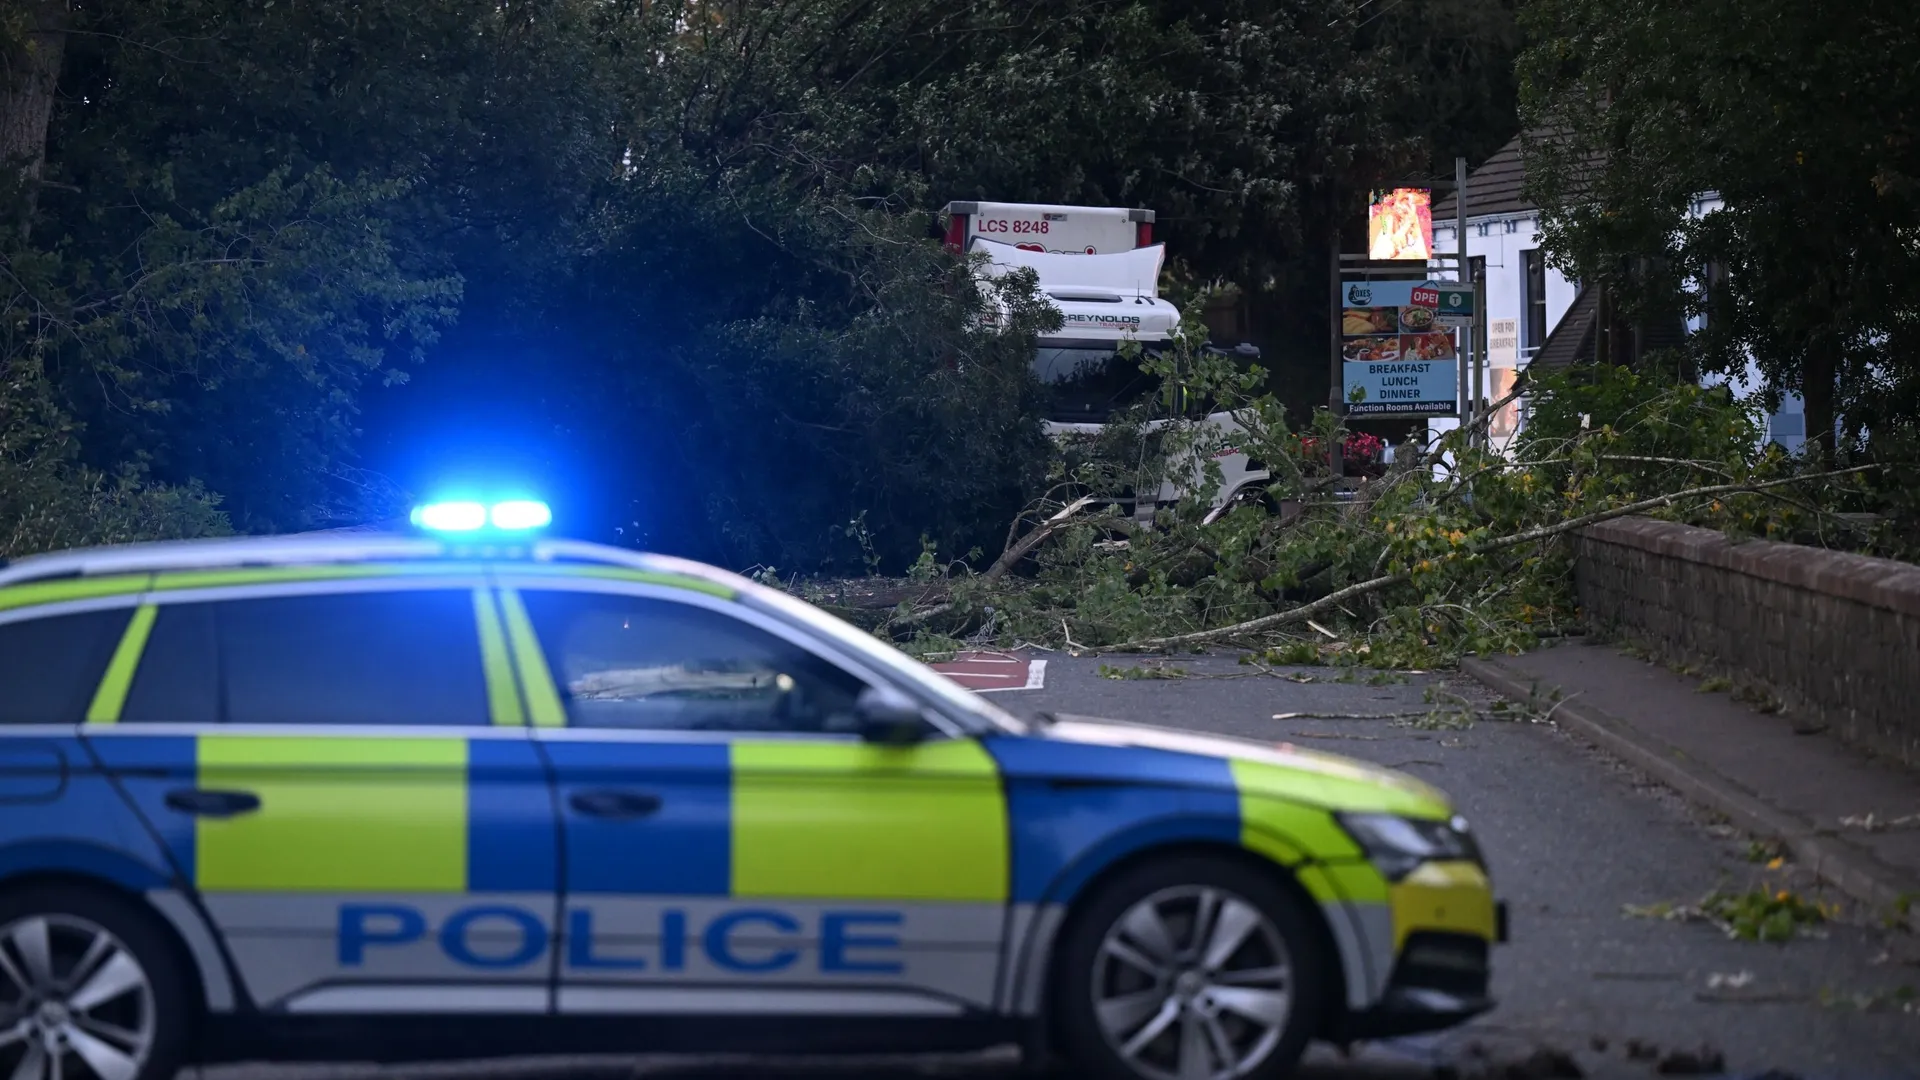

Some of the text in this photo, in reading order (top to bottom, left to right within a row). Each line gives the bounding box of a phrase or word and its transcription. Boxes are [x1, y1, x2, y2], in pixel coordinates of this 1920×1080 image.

[978, 219, 1049, 234] LCS 8248
[1369, 363, 1431, 374] BREAKFAST
[1382, 376, 1418, 387] LUNCH
[1379, 389, 1421, 399] DINNER
[1349, 401, 1451, 412] Function Rooms Available
[337, 903, 908, 974] POLICE
